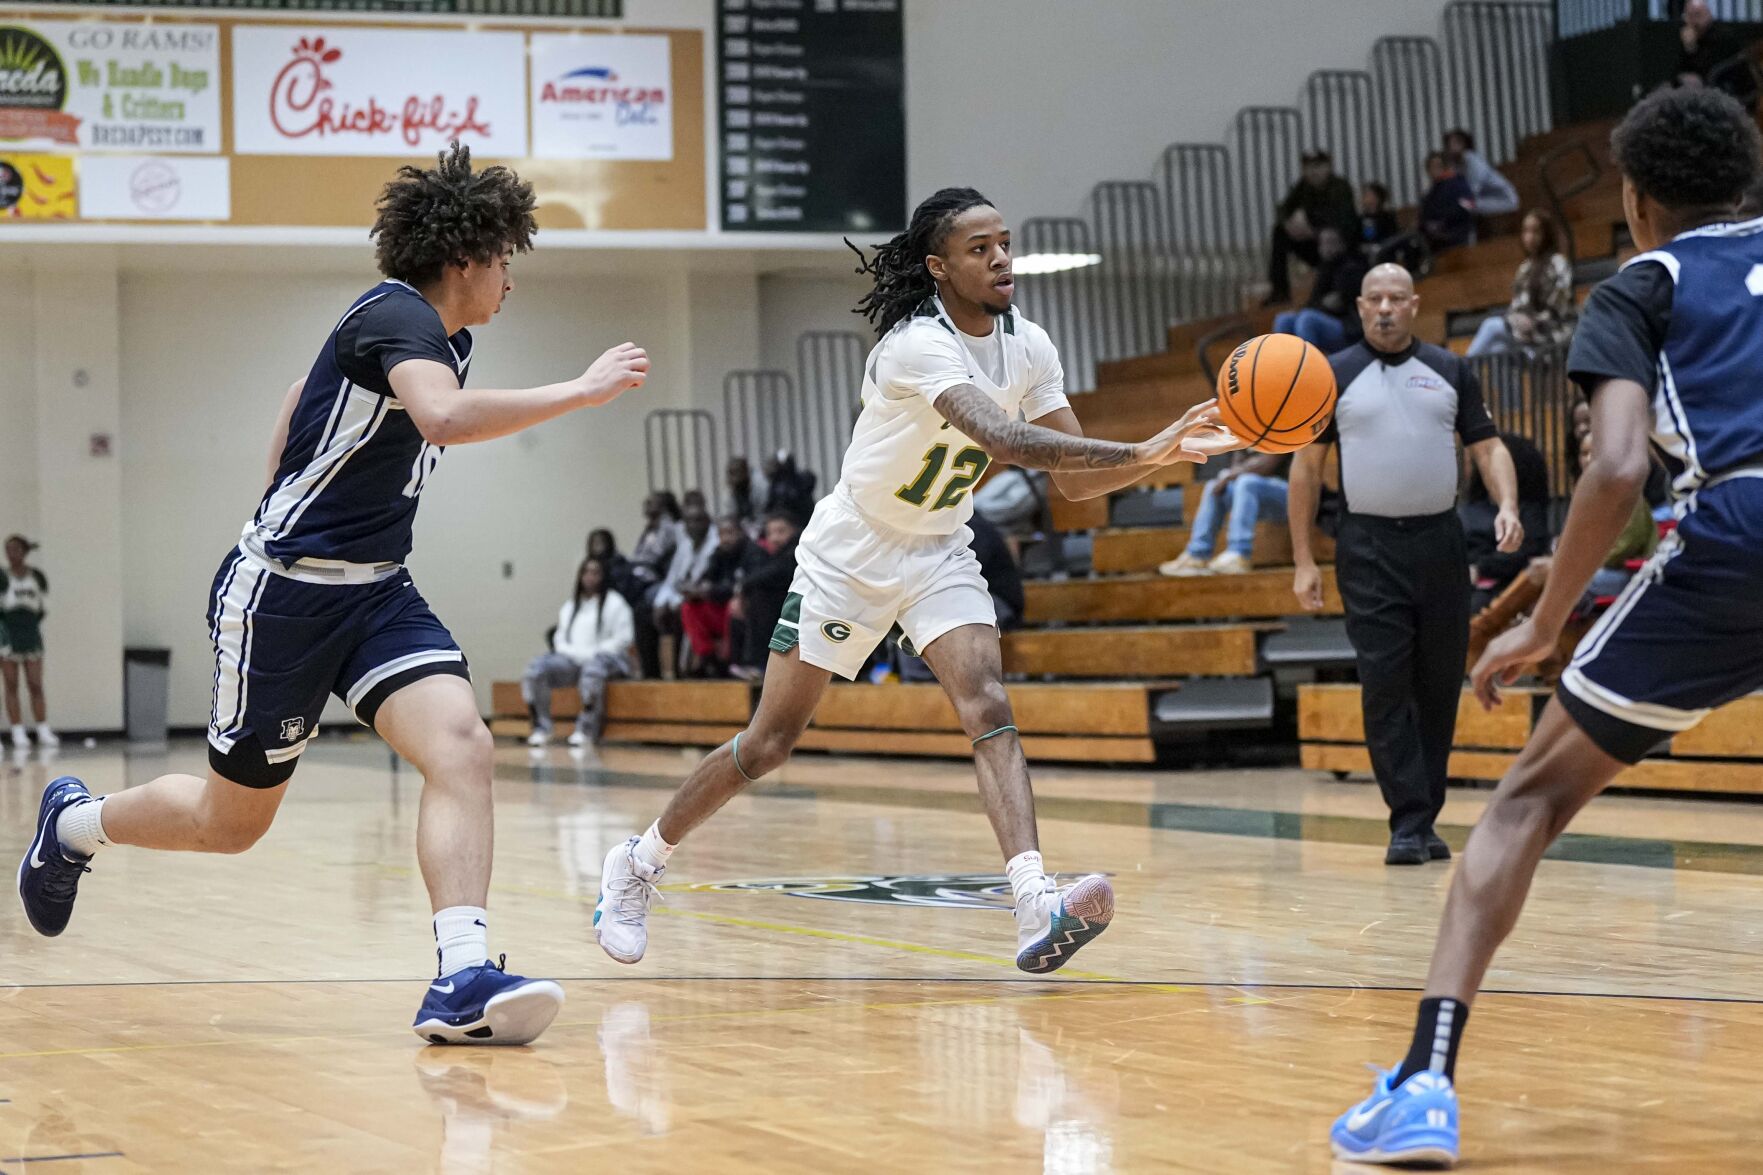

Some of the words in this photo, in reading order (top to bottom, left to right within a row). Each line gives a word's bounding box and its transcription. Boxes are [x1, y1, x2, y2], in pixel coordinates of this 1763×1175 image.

[68, 29, 114, 50] GO
[121, 30, 213, 51] RAMS!
[270, 56, 492, 146] Chick-fil-A
[541, 82, 665, 103] American
[894, 443, 992, 512] 12
[820, 620, 852, 643] G
